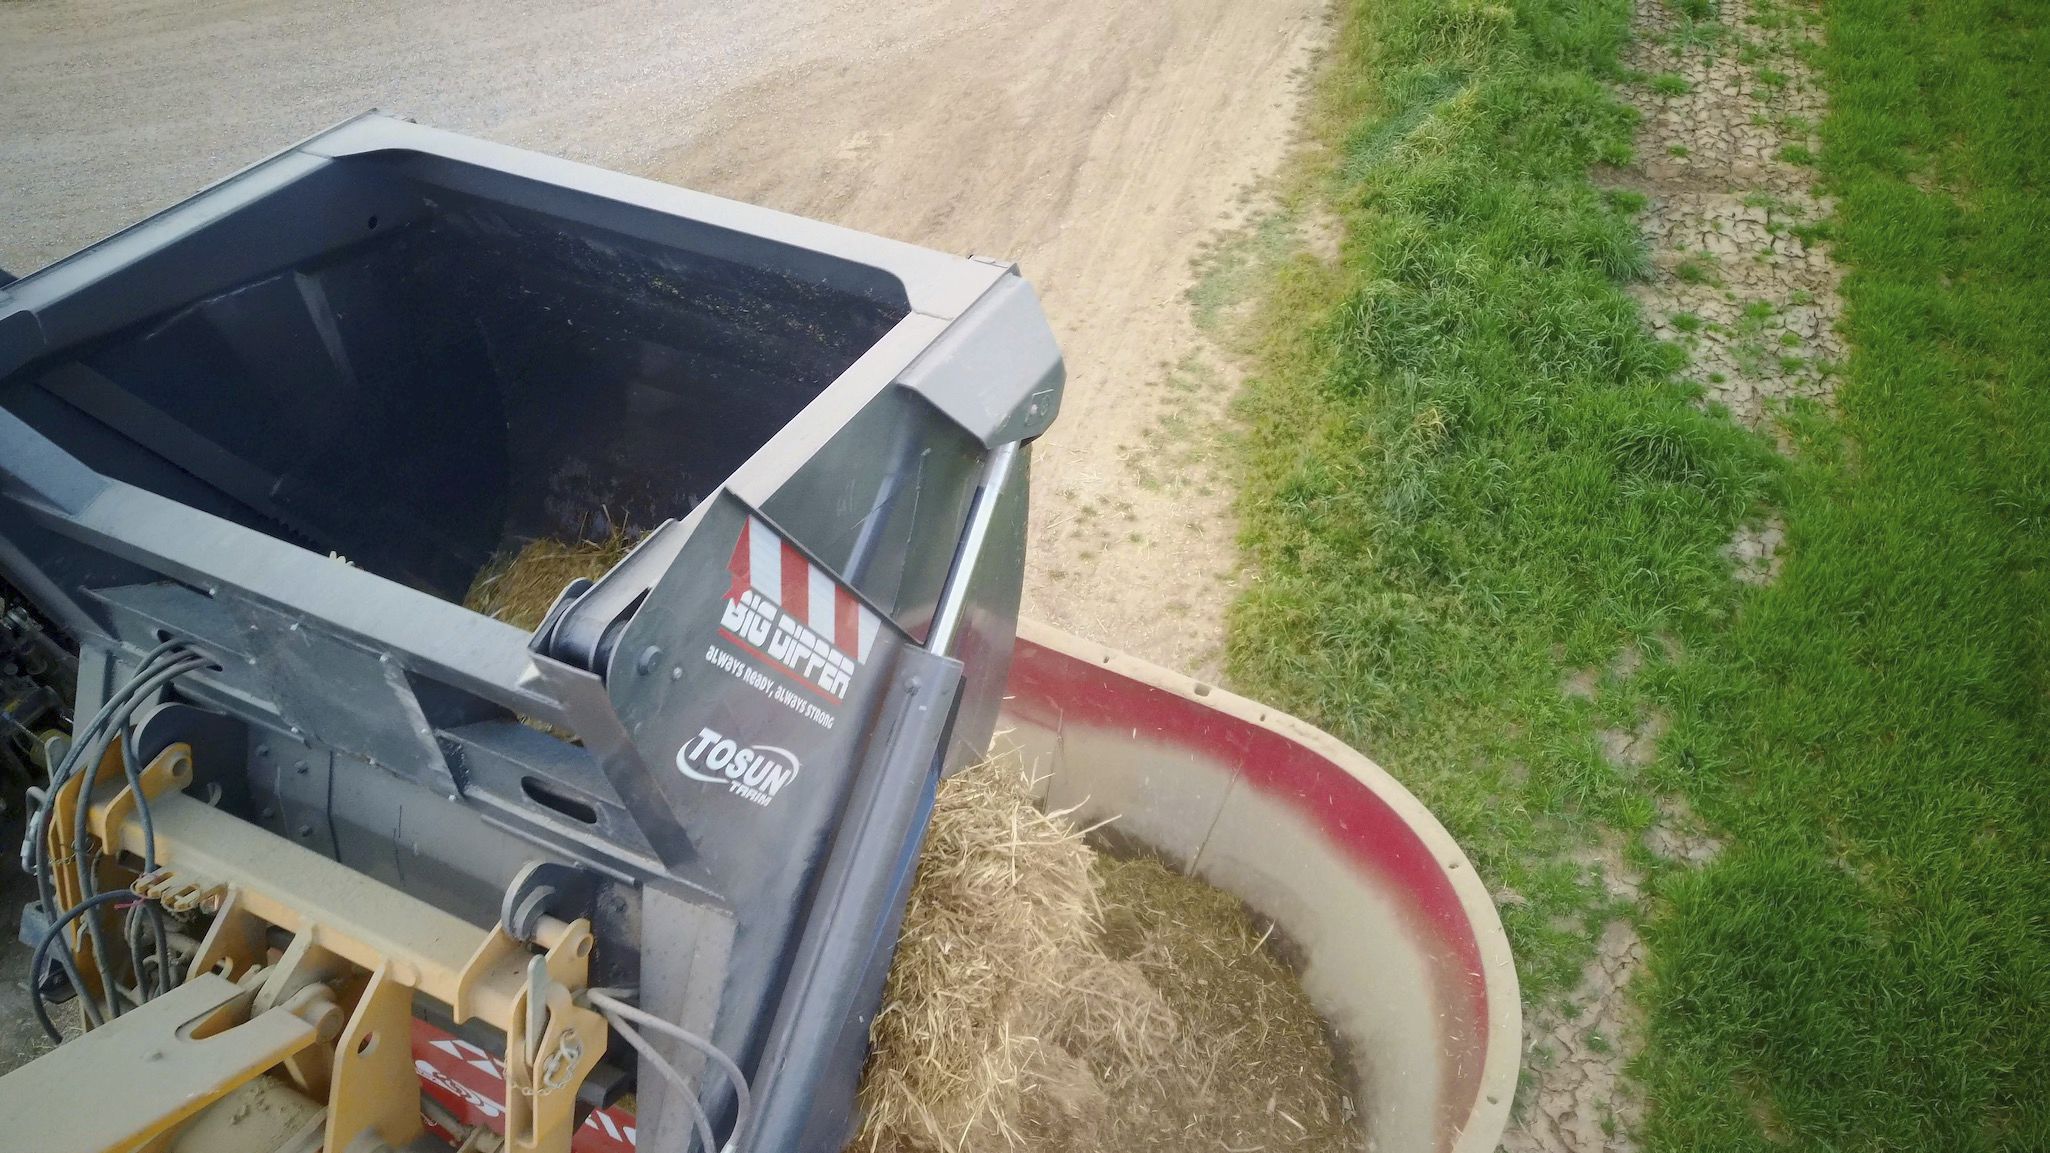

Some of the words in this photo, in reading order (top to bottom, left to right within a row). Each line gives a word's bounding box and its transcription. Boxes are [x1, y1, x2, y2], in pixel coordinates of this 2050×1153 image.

[720, 590, 778, 646] BIG
[767, 614, 854, 699] DIPPER
[688, 727, 792, 797] TOSUN
